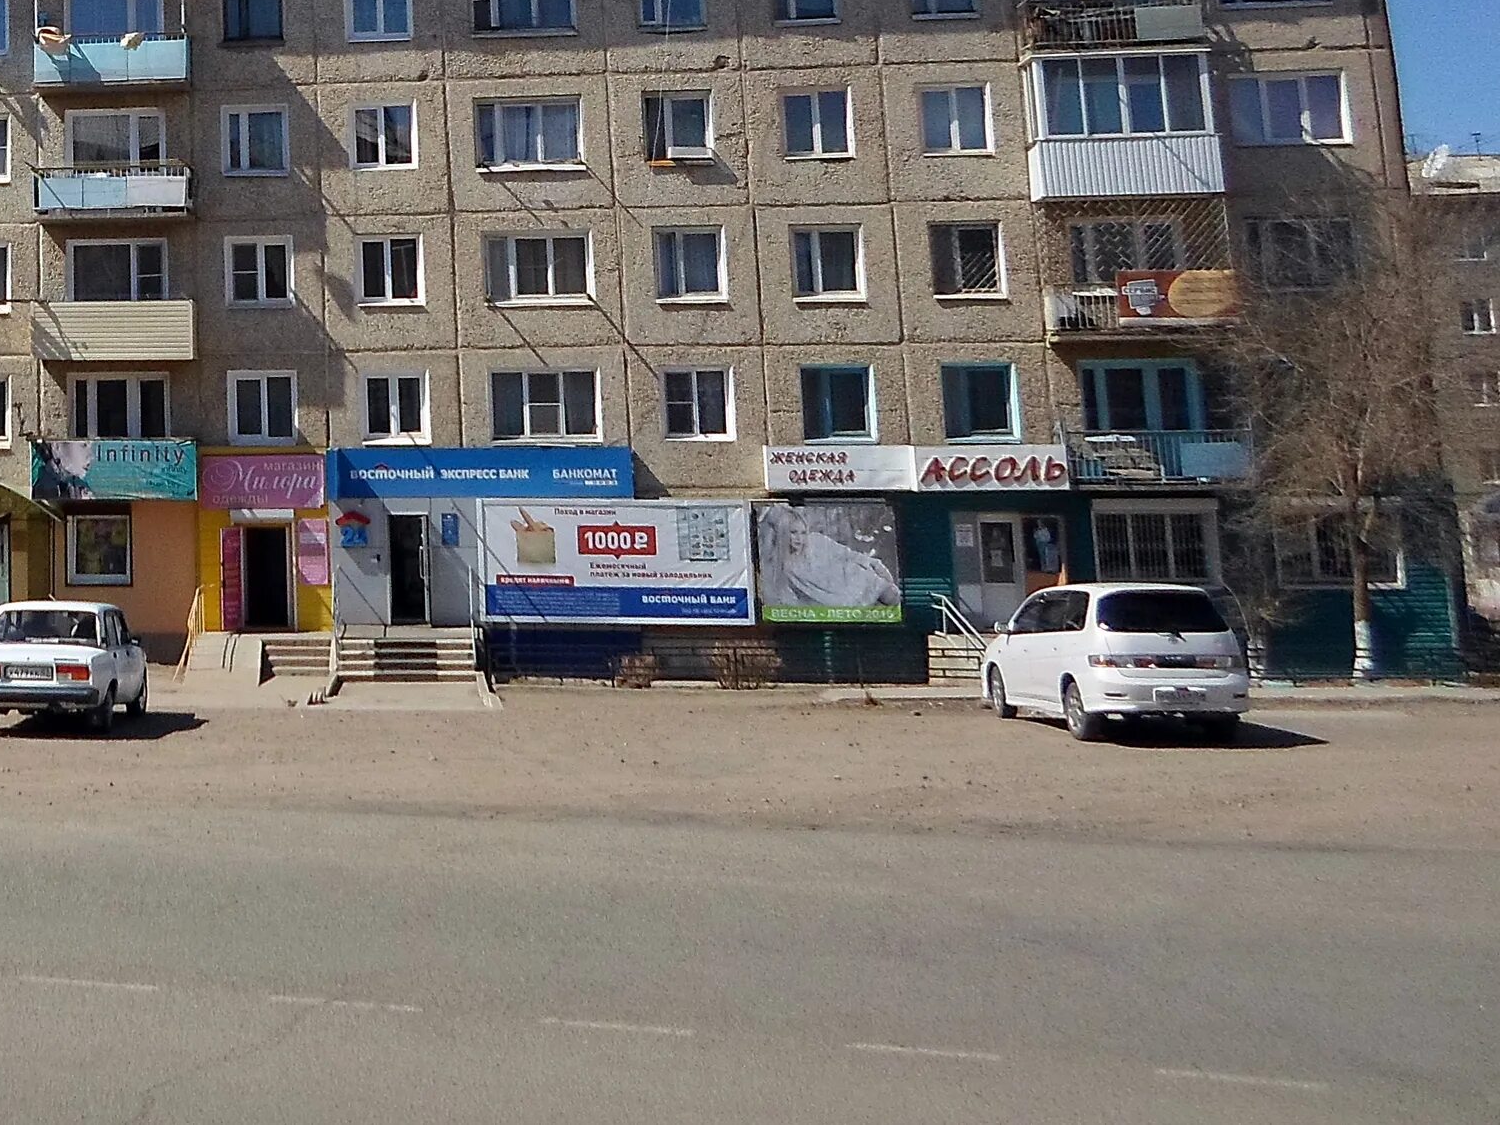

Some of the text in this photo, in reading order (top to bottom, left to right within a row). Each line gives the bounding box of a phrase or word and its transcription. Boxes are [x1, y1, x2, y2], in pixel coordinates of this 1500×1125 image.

[97, 444, 184, 466] Infinity
[770, 451, 848, 465] ЖЕНСКАЯ
[263, 461, 320, 472] магазин
[920, 455, 1067, 486] АССОЛЬ
[441, 469, 498, 480] ЭКСПРЕСС
[499, 469, 530, 480] БАНК
[552, 468, 618, 480] БАНКОМАТ
[789, 468, 857, 484] ОДЕЖДА
[212, 495, 269, 505] одежды
[554, 507, 578, 516] Поход
[585, 508, 617, 516] магазин
[631, 572, 659, 580] новый
[659, 572, 713, 580] холодильник
[710, 596, 736, 604] БАНК
[771, 608, 816, 619] ВЕСНА
[827, 609, 862, 620] ЛЕТО
